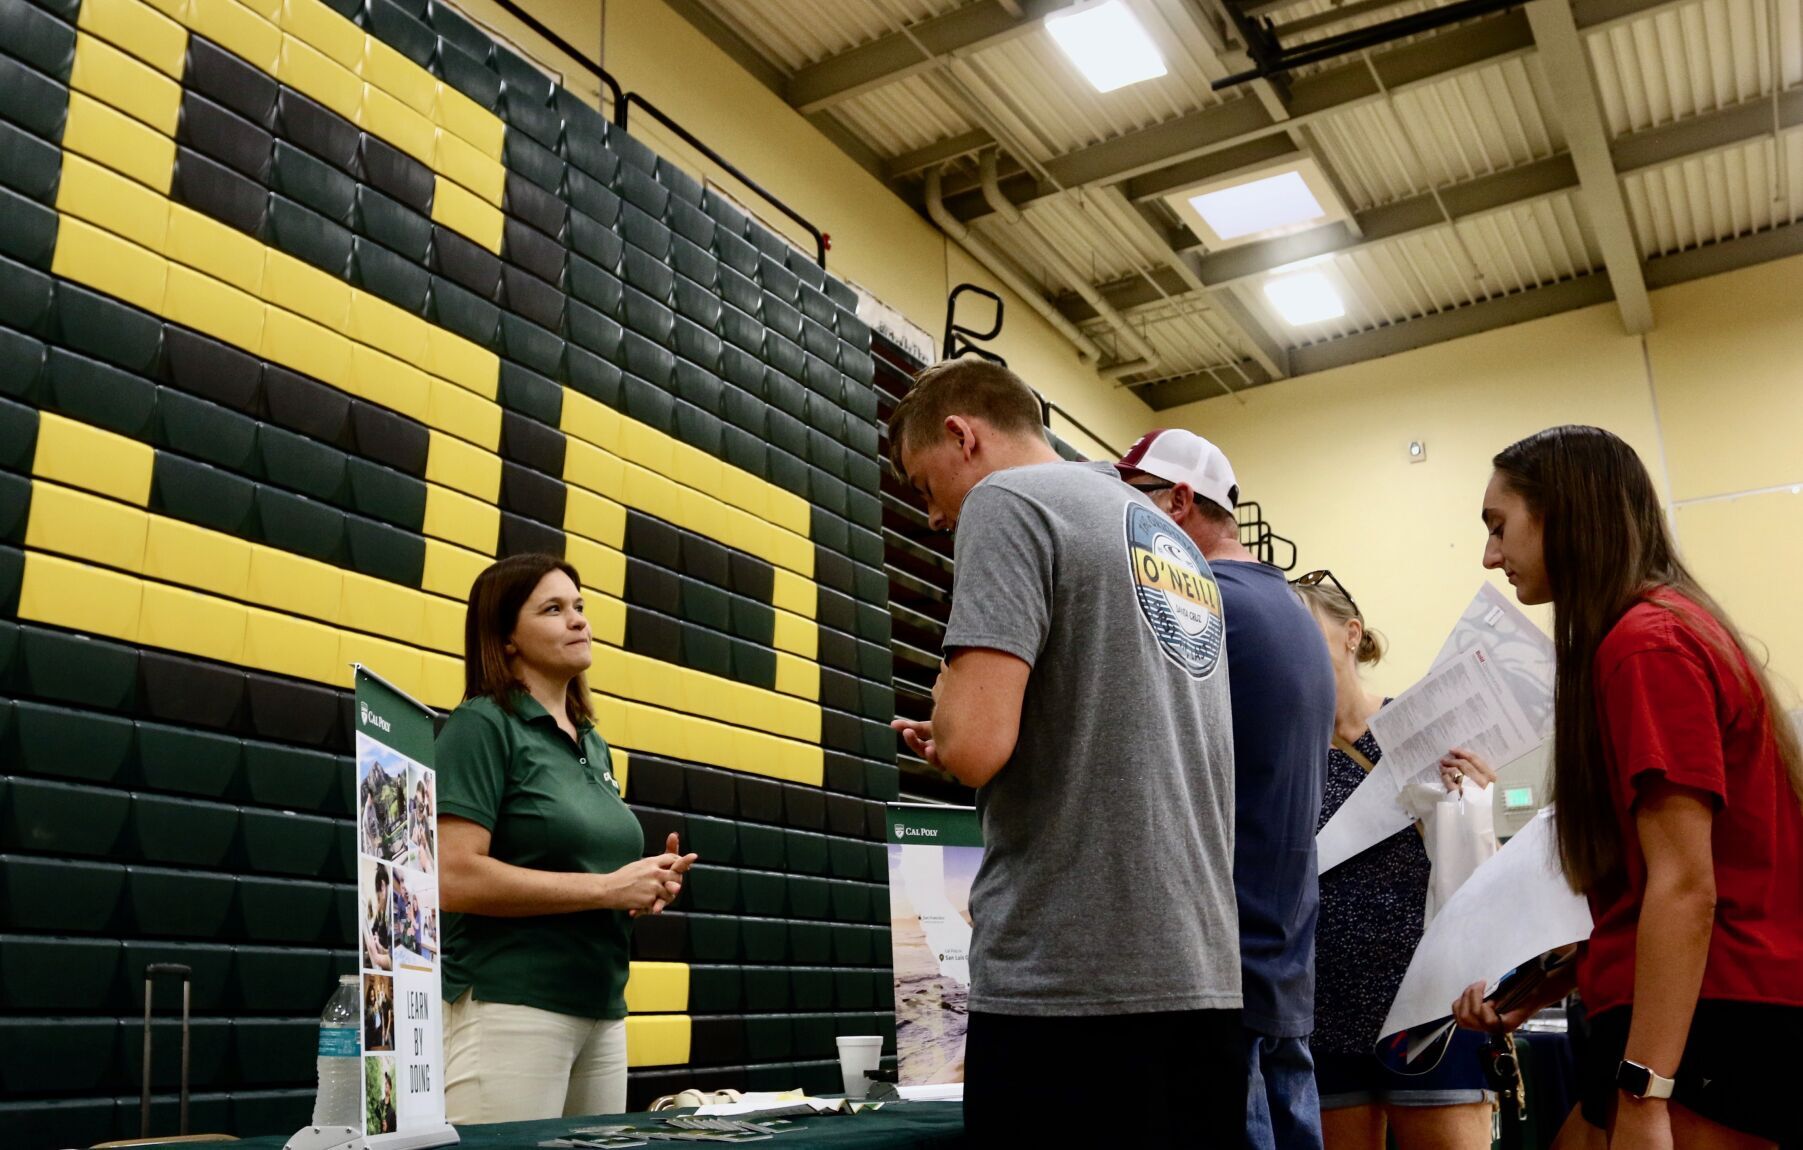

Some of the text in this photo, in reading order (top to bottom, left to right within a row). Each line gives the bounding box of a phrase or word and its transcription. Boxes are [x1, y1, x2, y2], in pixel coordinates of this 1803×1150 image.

[1144, 555, 1216, 608] O'NEILL
[1189, 609, 1202, 623] CRUZ
[368, 710, 391, 732] CAL POLY
[905, 827, 938, 836] CAL POLY
[407, 990, 428, 1020] LEARN
[414, 1028, 423, 1056] BY
[410, 1064, 430, 1093] DOING
